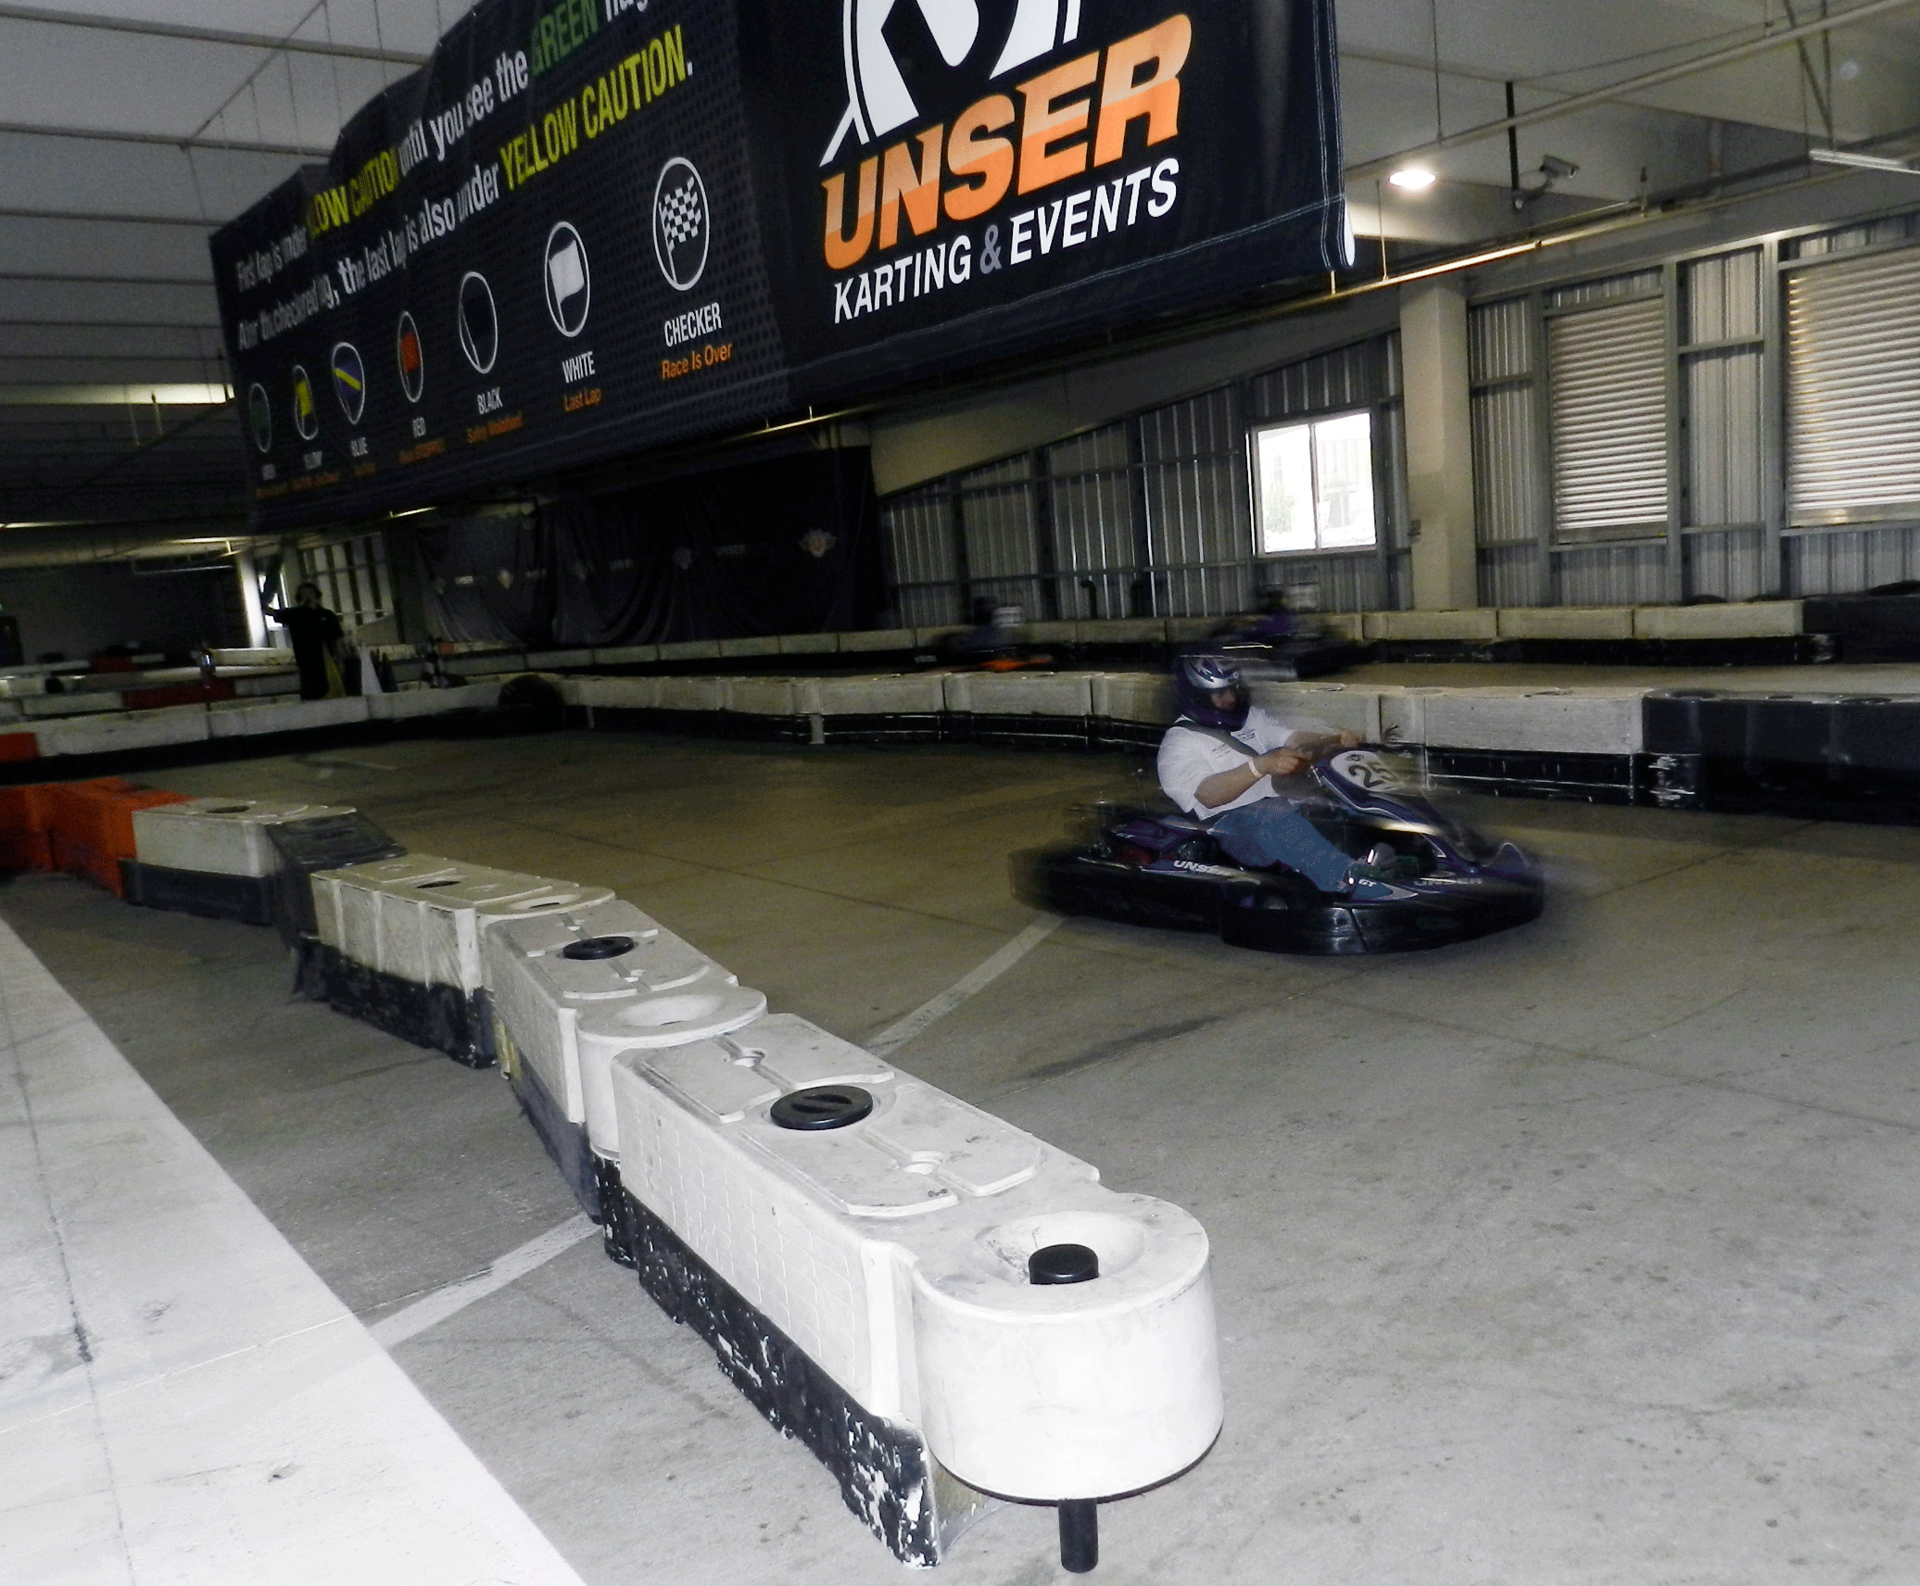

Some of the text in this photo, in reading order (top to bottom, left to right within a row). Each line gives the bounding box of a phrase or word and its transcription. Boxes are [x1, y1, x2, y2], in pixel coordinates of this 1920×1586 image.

[429, 102, 465, 162] you
[466, 76, 494, 128] see
[496, 50, 529, 102] the
[821, 13, 1193, 271] UNSER
[337, 257, 366, 295] the
[364, 236, 392, 282] last
[404, 214, 419, 253] is
[418, 198, 456, 244] also
[457, 162, 500, 223] under
[500, 98, 578, 191] YELLOW
[833, 157, 1180, 325] KARTING & EVENTS
[664, 302, 723, 347] CHECKER
[562, 351, 596, 384] WHITE
[661, 343, 733, 380] Race Is Over
[477, 386, 504, 415] BLACK
[563, 389, 583, 412] Last
[1173, 860, 1231, 877] UNS
